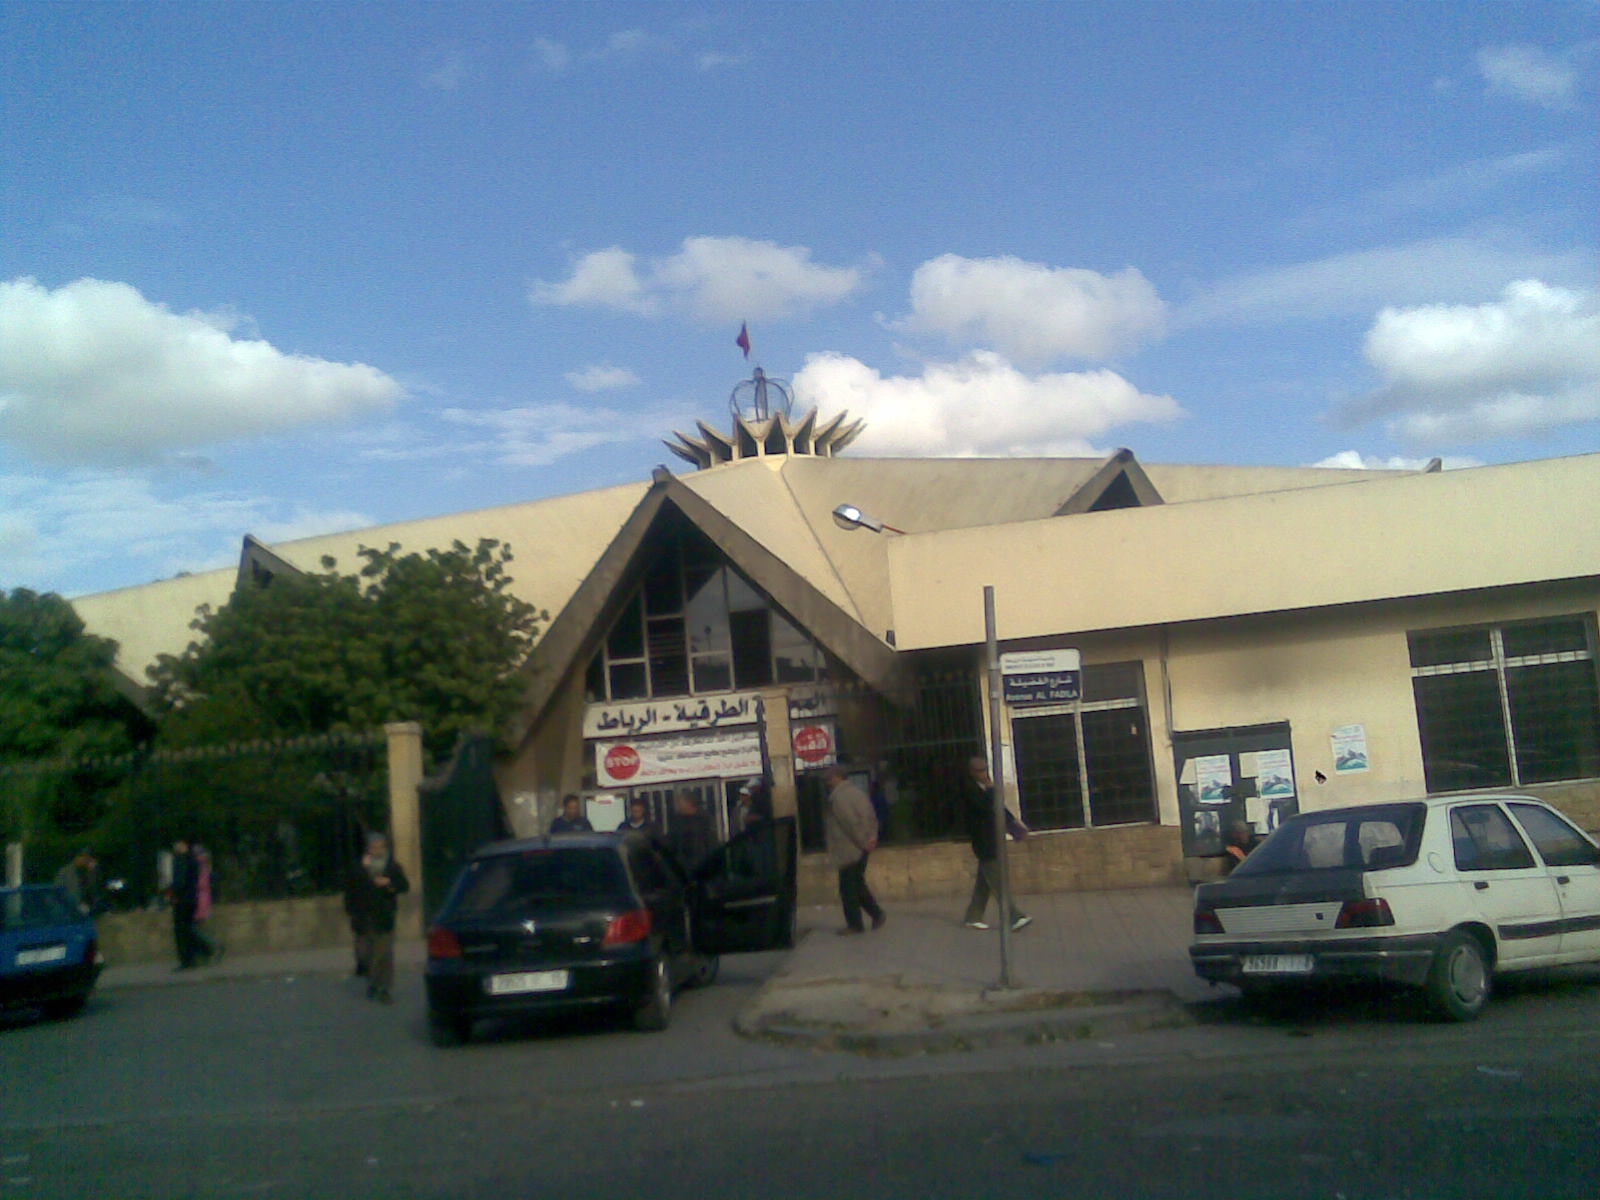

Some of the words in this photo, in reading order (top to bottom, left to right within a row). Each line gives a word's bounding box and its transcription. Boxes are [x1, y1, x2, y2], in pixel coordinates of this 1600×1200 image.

[597, 707, 657, 735] الرباط
[674, 698, 749, 728] الطرقية
[607, 755, 638, 768] STOP
